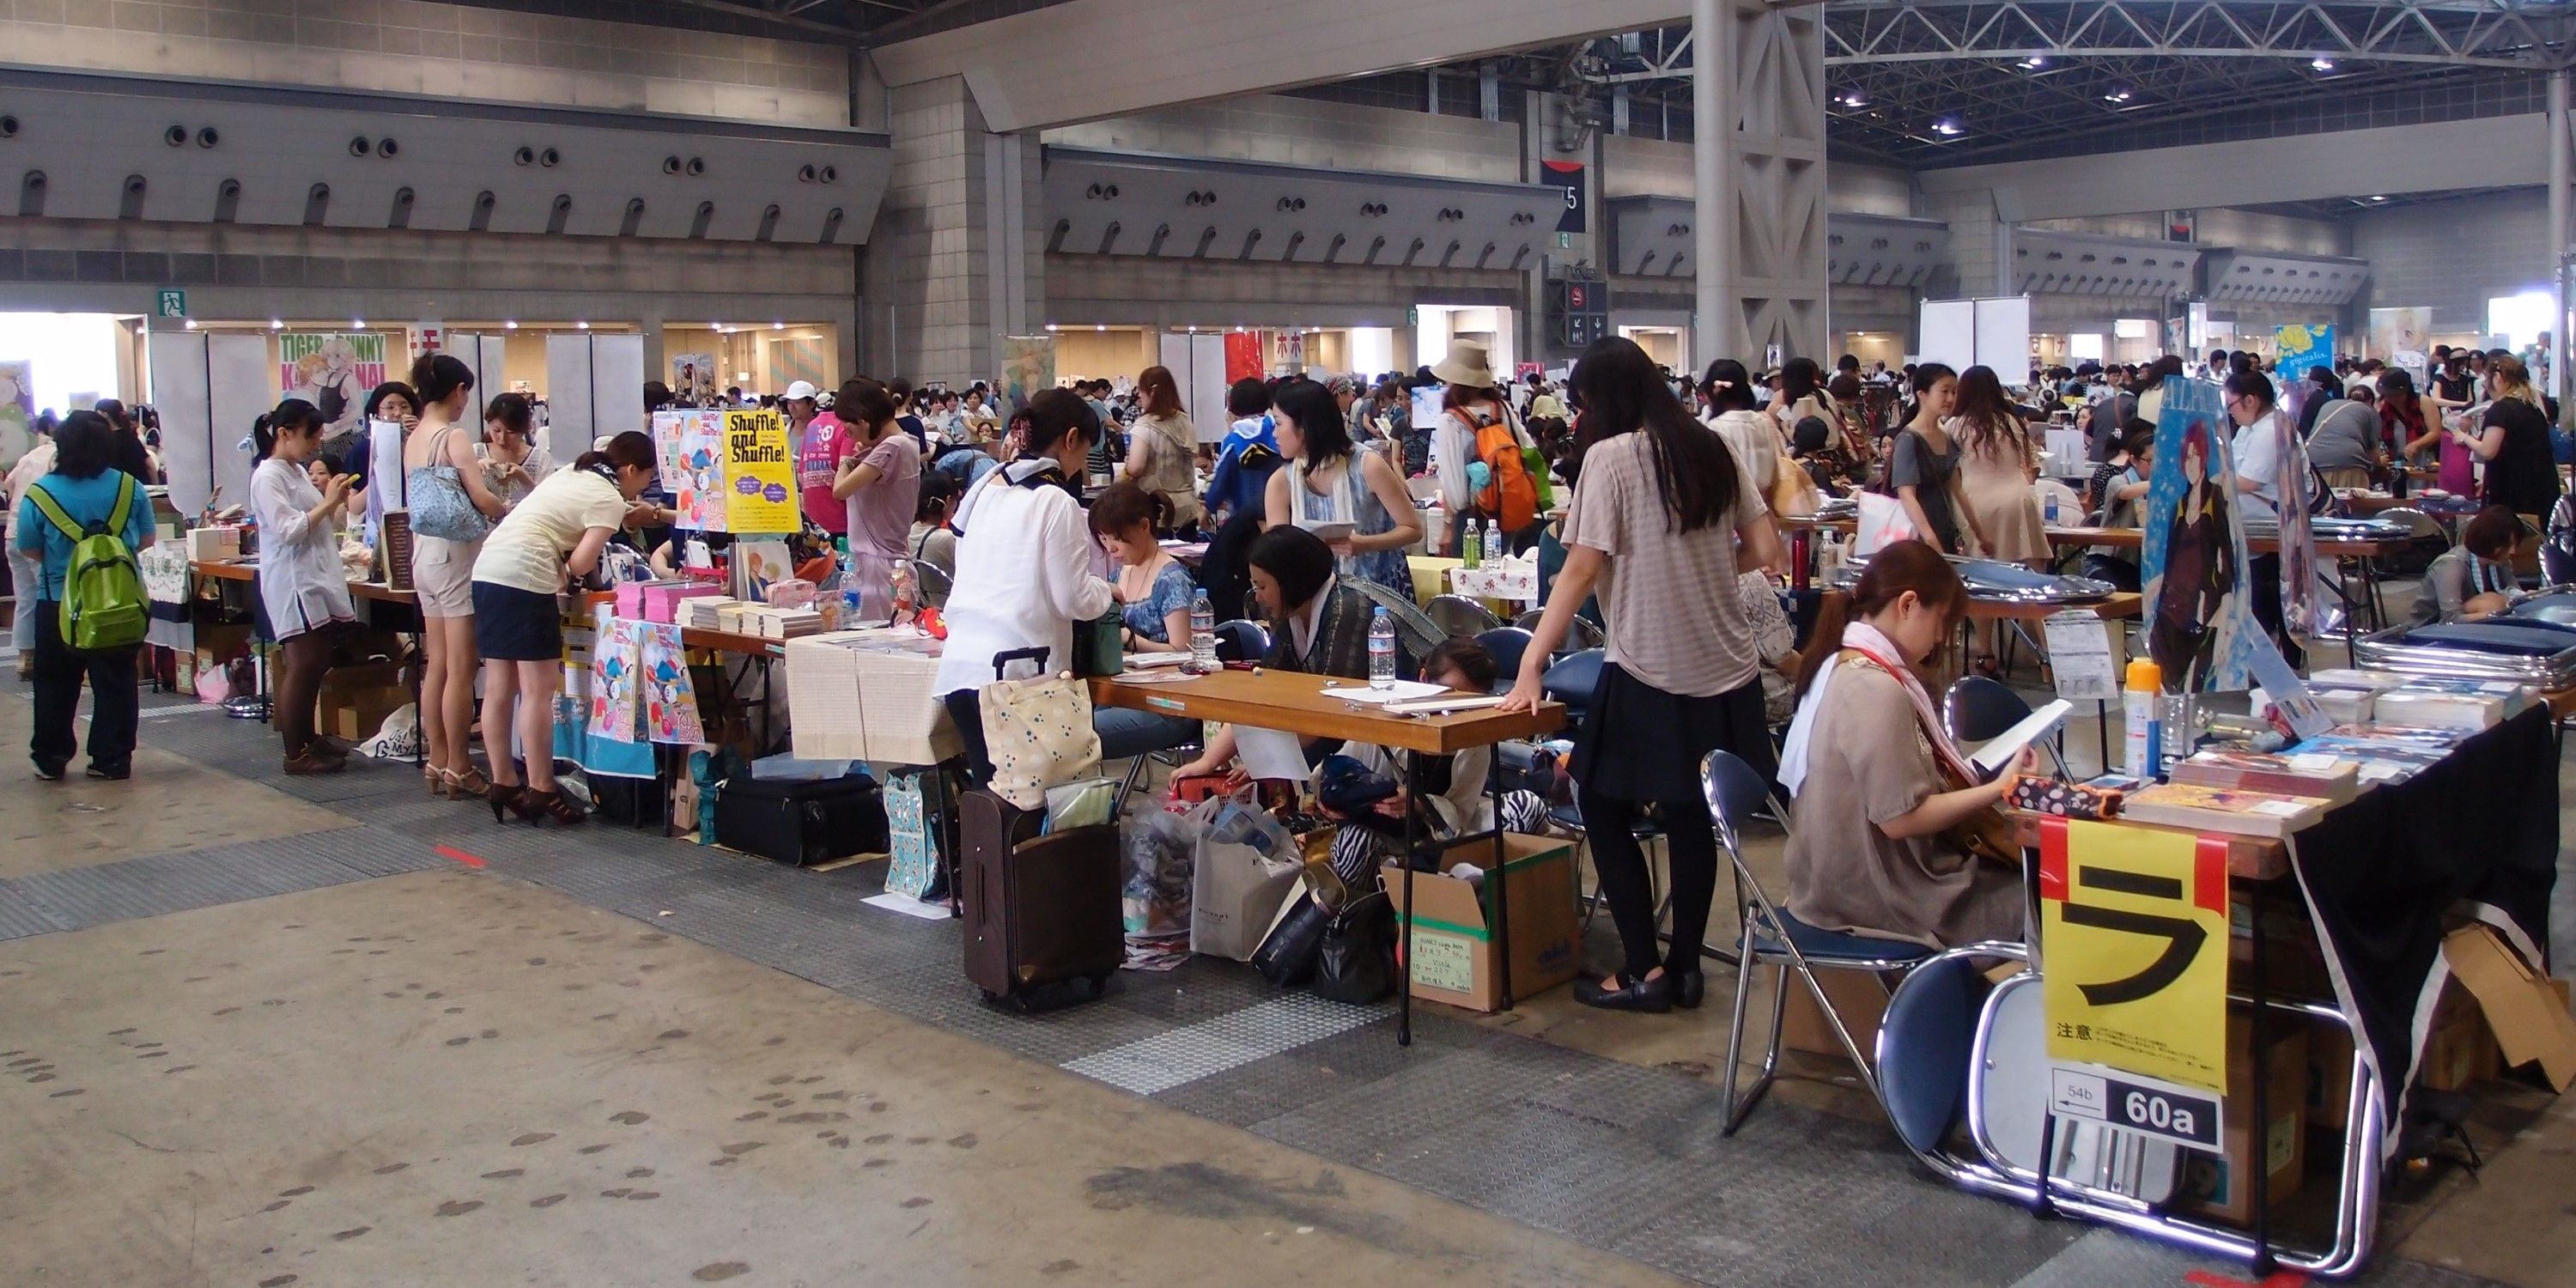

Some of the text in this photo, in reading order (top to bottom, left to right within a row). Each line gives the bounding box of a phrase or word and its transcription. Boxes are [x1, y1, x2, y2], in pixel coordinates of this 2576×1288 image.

[730, 413, 780, 432] Shuffle!
[731, 428, 757, 447] and
[732, 445, 785, 463] Shuffle!
[2061, 865, 2208, 1006] ラ
[2057, 1023, 2093, 1040] 注意
[2068, 1085, 2093, 1100] 54b
[2125, 1091, 2195, 1134] 60a
